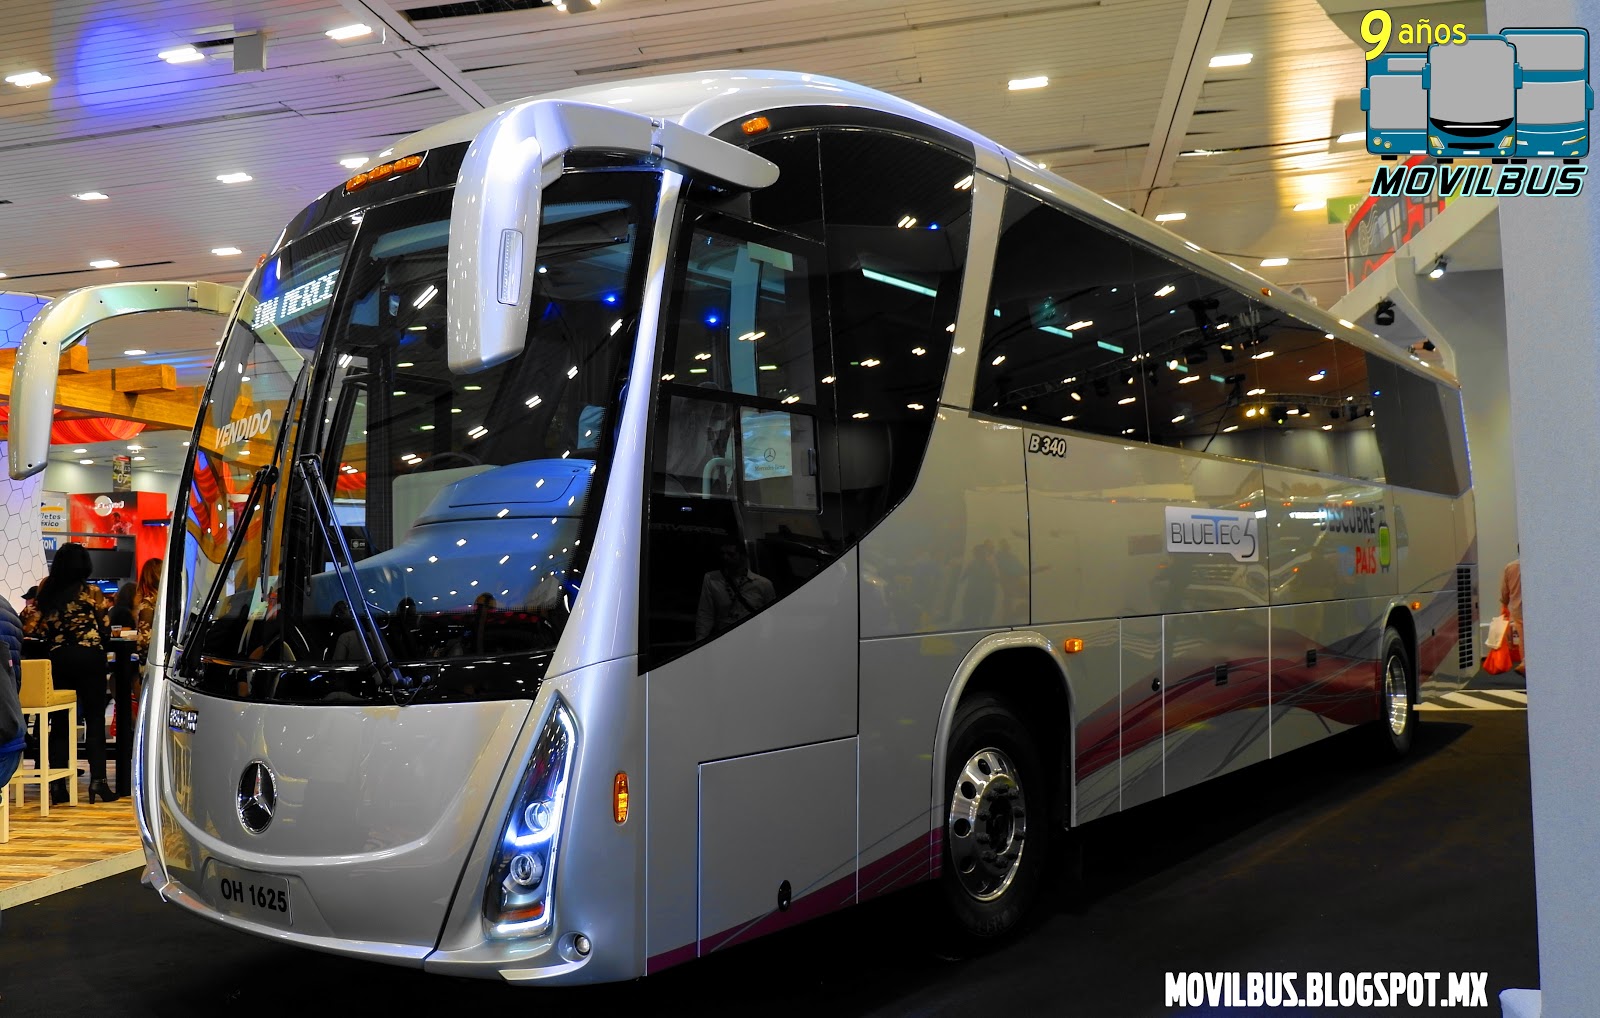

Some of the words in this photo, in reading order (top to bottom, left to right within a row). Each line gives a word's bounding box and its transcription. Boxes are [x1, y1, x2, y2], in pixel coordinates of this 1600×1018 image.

[215, 408, 272, 450] VENDIDO
[1028, 433, 1041, 453] B
[1041, 435, 1067, 458] 340
[117, 473, 129, 484] 07
[1355, 538, 1377, 575] PAÍS
[221, 878, 244, 903] OH
[249, 884, 287, 913] 1625
